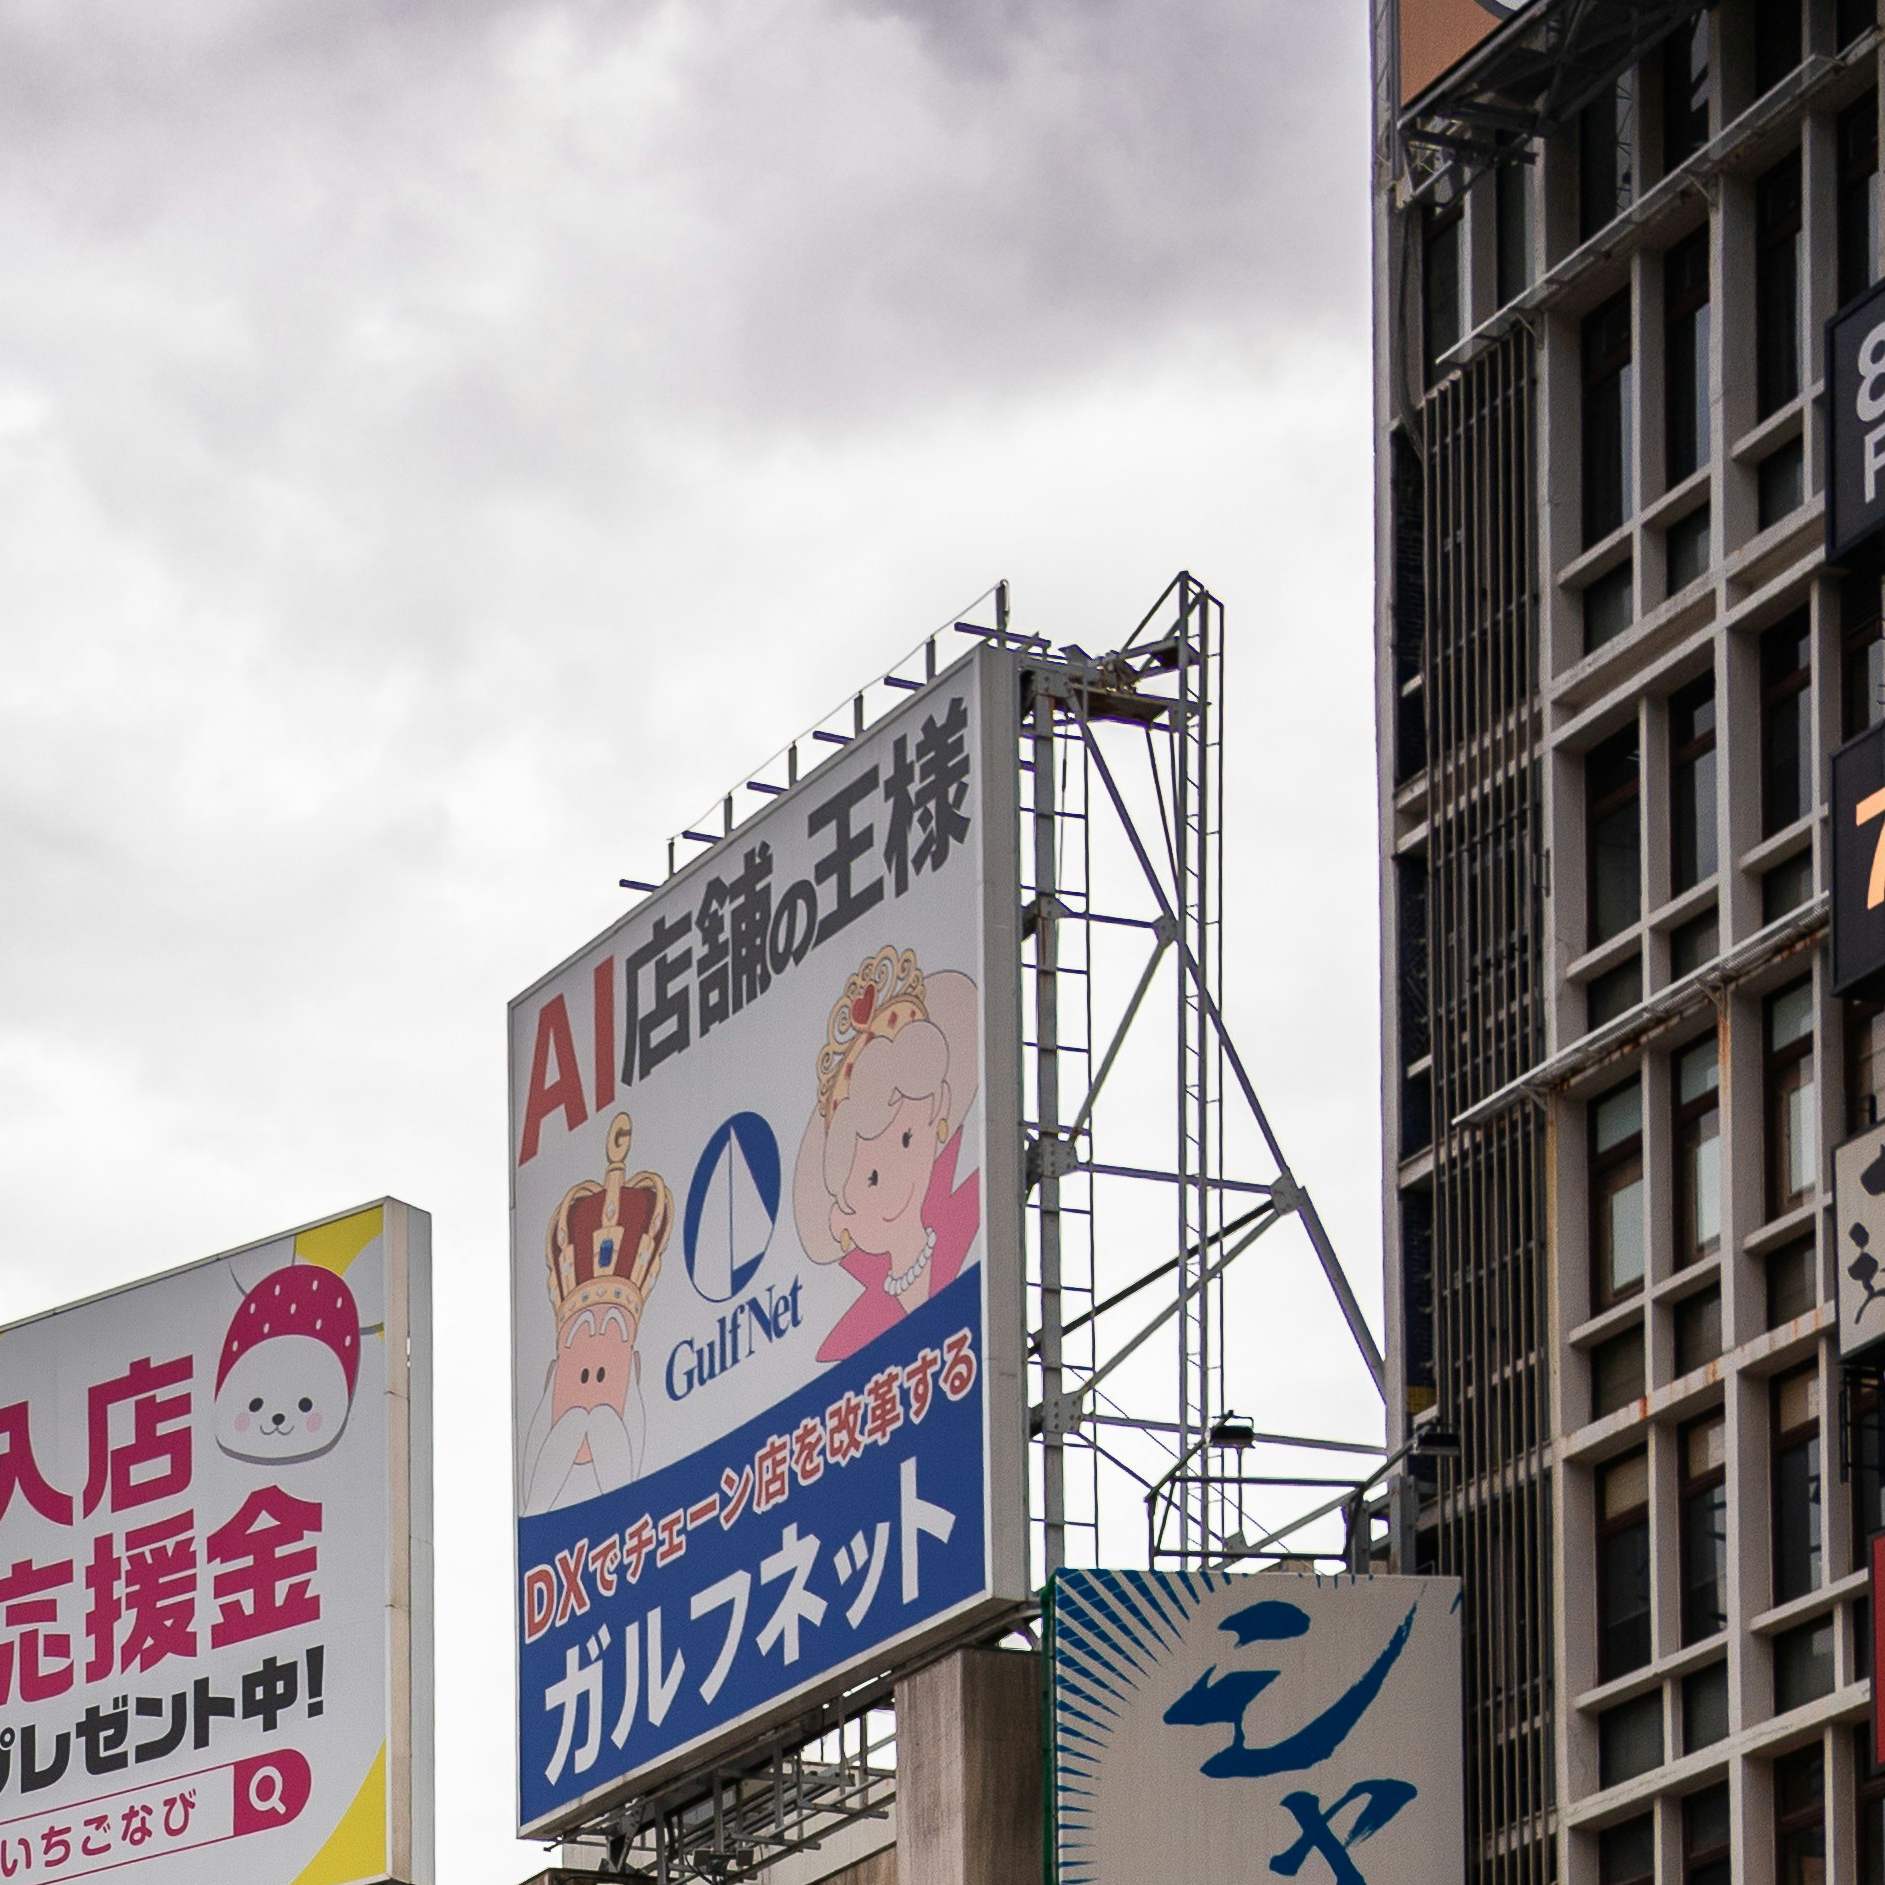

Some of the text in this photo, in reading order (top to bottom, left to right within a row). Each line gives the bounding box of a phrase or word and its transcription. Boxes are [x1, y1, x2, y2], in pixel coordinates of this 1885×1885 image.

[518, 695, 972, 1167] AI店舗の王様
[523, 1326, 978, 1644] DXでチェーン店を改革する
[543, 1453, 956, 1788] ガルフネット
